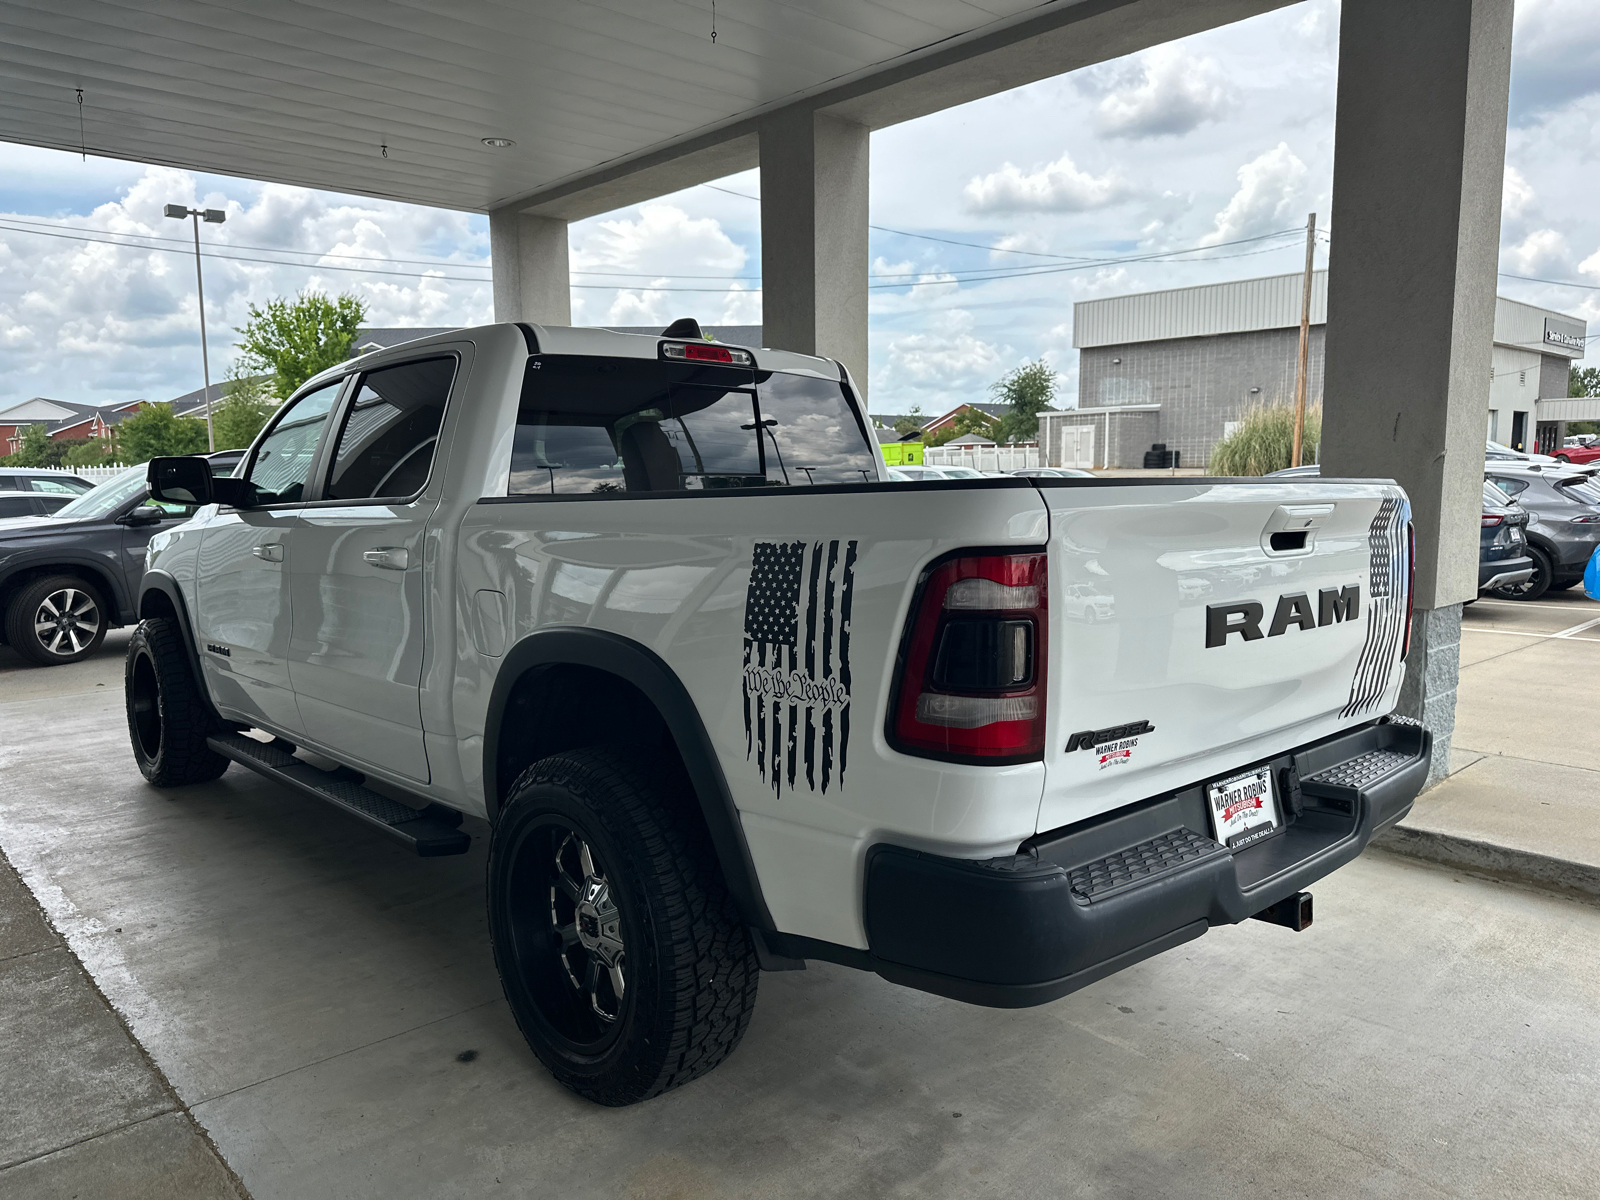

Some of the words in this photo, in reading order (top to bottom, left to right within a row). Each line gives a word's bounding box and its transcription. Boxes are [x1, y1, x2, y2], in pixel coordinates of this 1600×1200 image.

[1205, 583, 1360, 649] RAM
[744, 666, 772, 698] We
[790, 673, 847, 712] People
[1065, 719, 1156, 753] REBEL
[1095, 742, 1118, 755] WARNER
[1118, 738, 1139, 750] ROBINS
[1214, 788, 1242, 811] WARNER
[1242, 779, 1267, 800] ROBINS
[1236, 838, 1245, 847] JUST
[1251, 832, 1259, 841] THE
